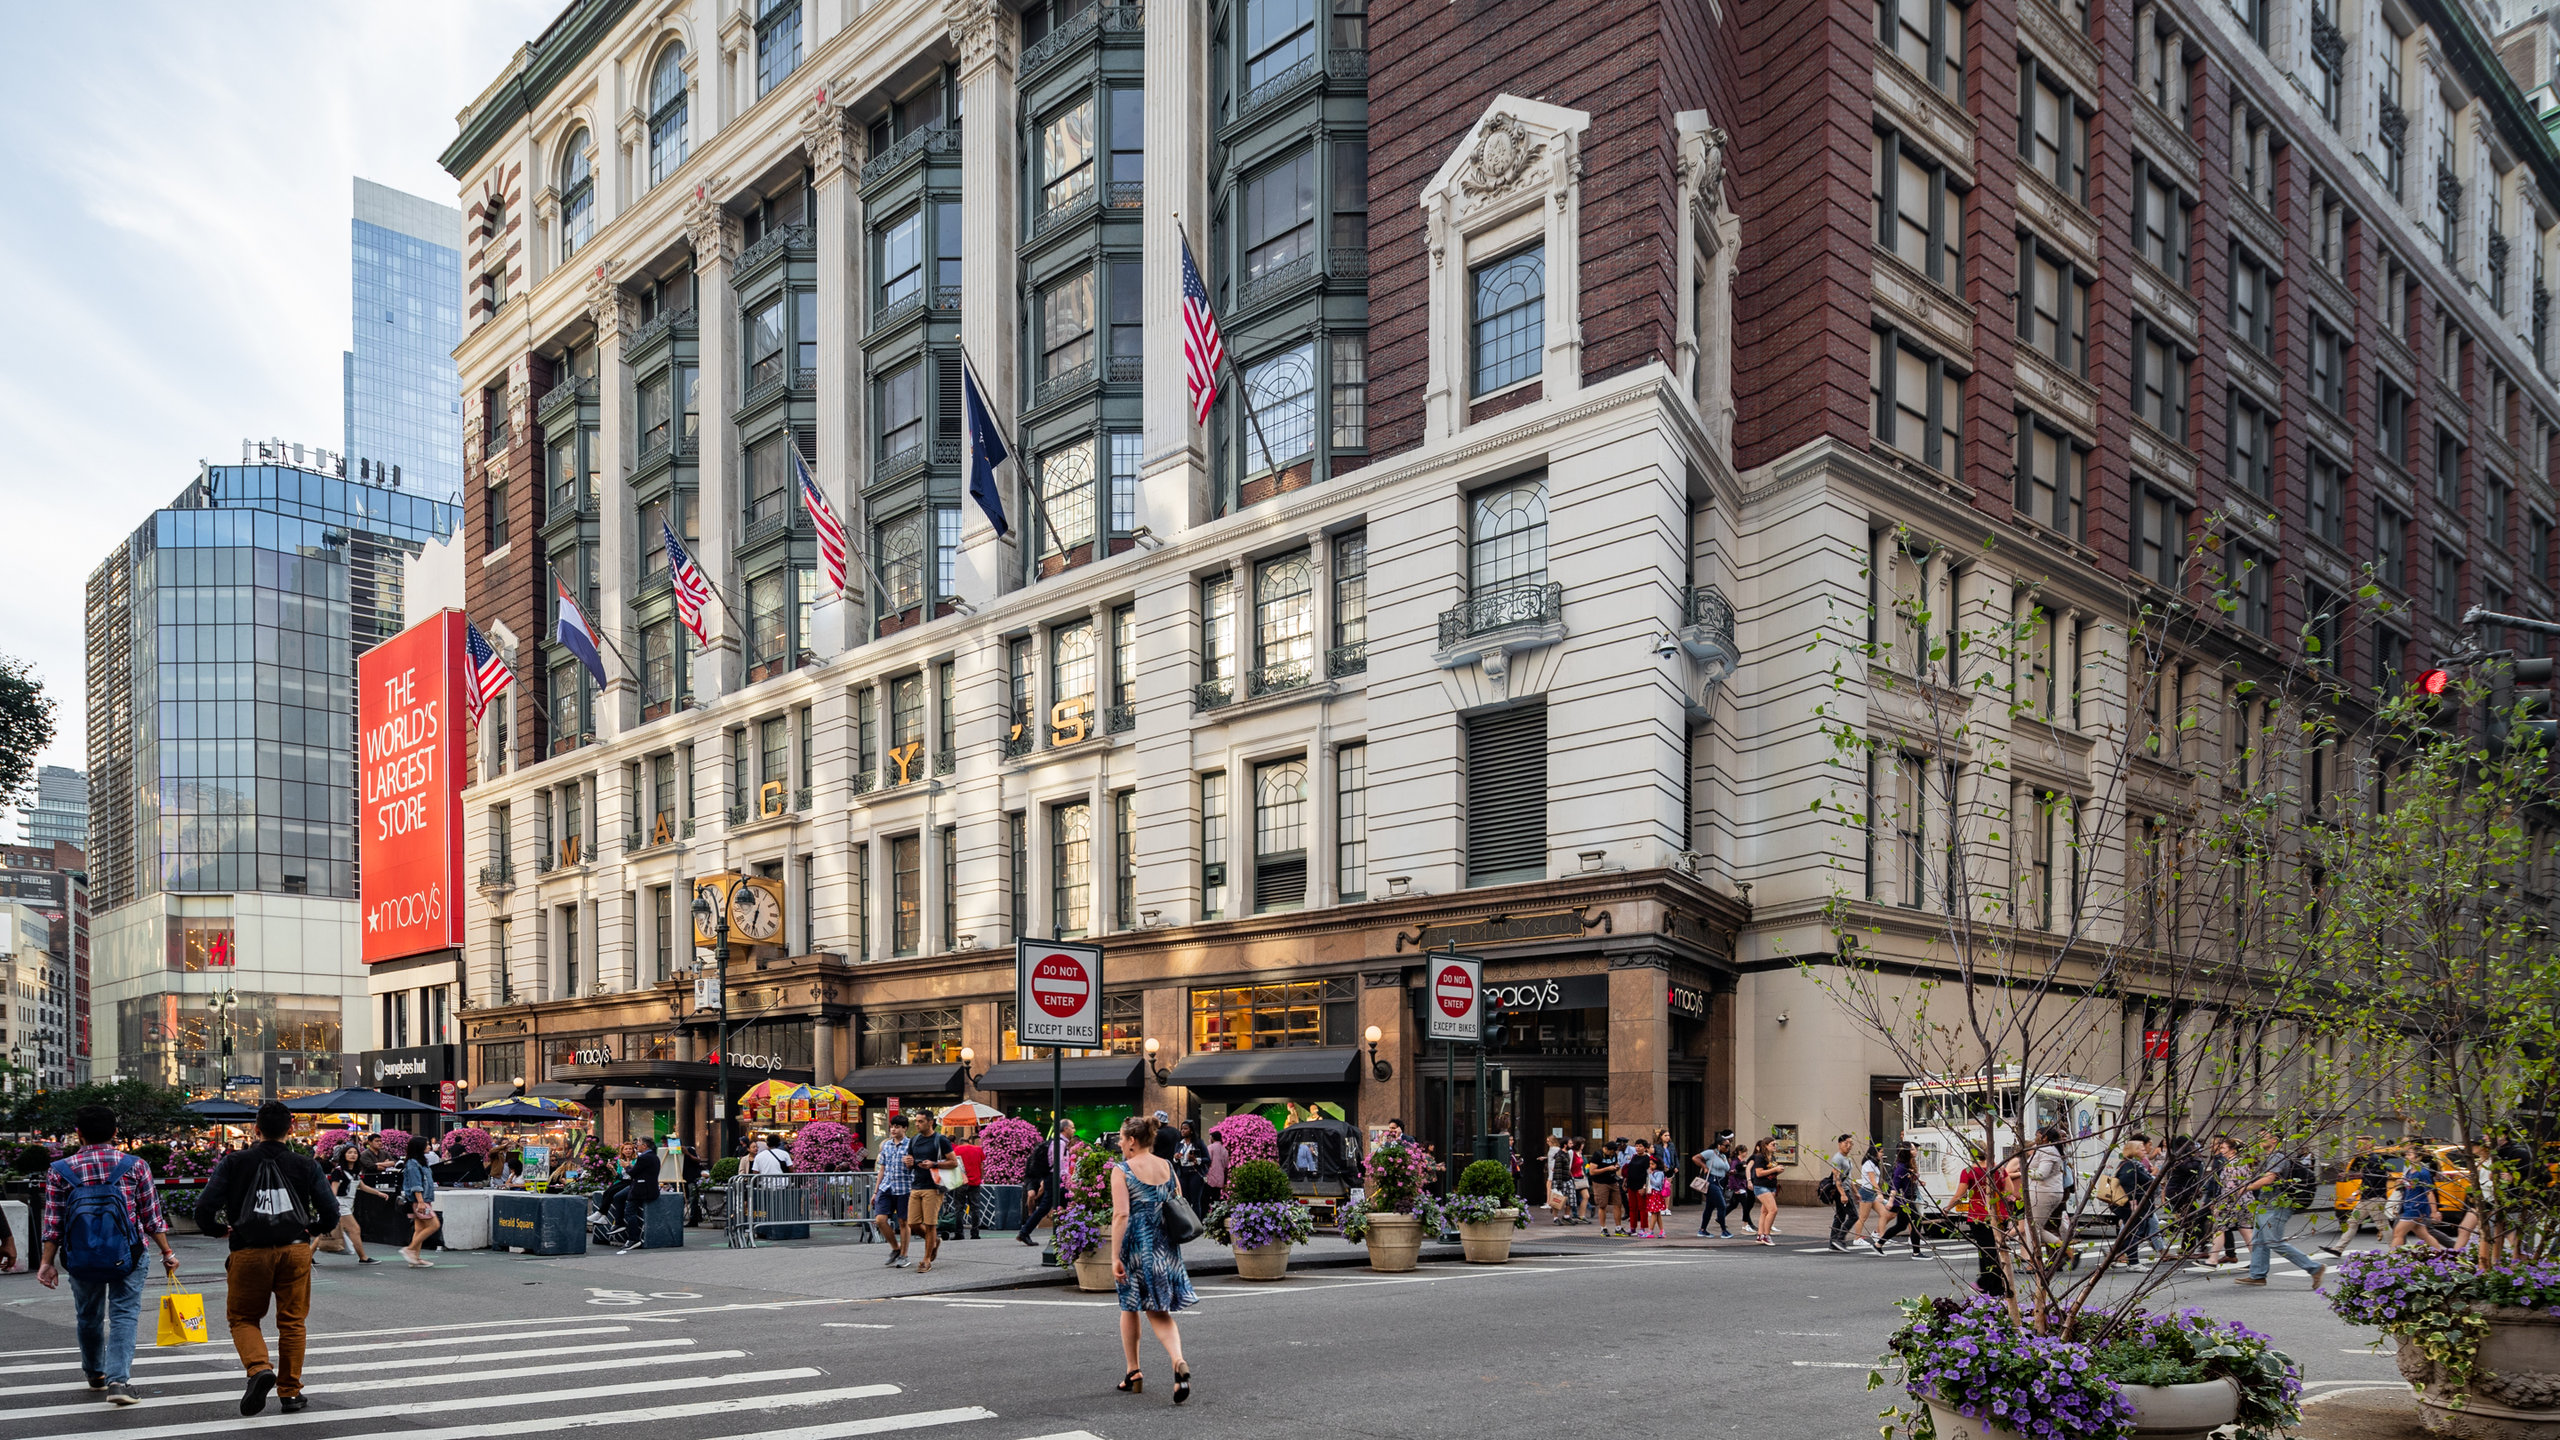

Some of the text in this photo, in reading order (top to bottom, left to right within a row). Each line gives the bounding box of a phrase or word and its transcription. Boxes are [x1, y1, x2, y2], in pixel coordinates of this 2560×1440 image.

[384, 667, 416, 714] THE
[366, 700, 438, 764] WORLD'S
[367, 744, 436, 804] LARGEST
[378, 791, 428, 841] STORE
[380, 882, 441, 933] macy's
[1043, 965, 1078, 977] DO NOT
[1443, 974, 1466, 985] DO NOT
[1044, 995, 1075, 1007] ENTER
[1443, 999, 1465, 1009] ENTER
[1674, 988, 1704, 1019] macy's
[1028, 1023, 1094, 1037] EXCEPT BIKES
[1433, 1021, 1477, 1033] EXCEPT BIKES
[1512, 1024, 1606, 1042] TELL
[575, 1045, 610, 1067] macy's
[1541, 1047, 1608, 1056] TRATTOR
[384, 1057, 427, 1080] sunglass hut
[726, 1052, 783, 1074] macy's
[498, 1217, 534, 1231] Herald Square
